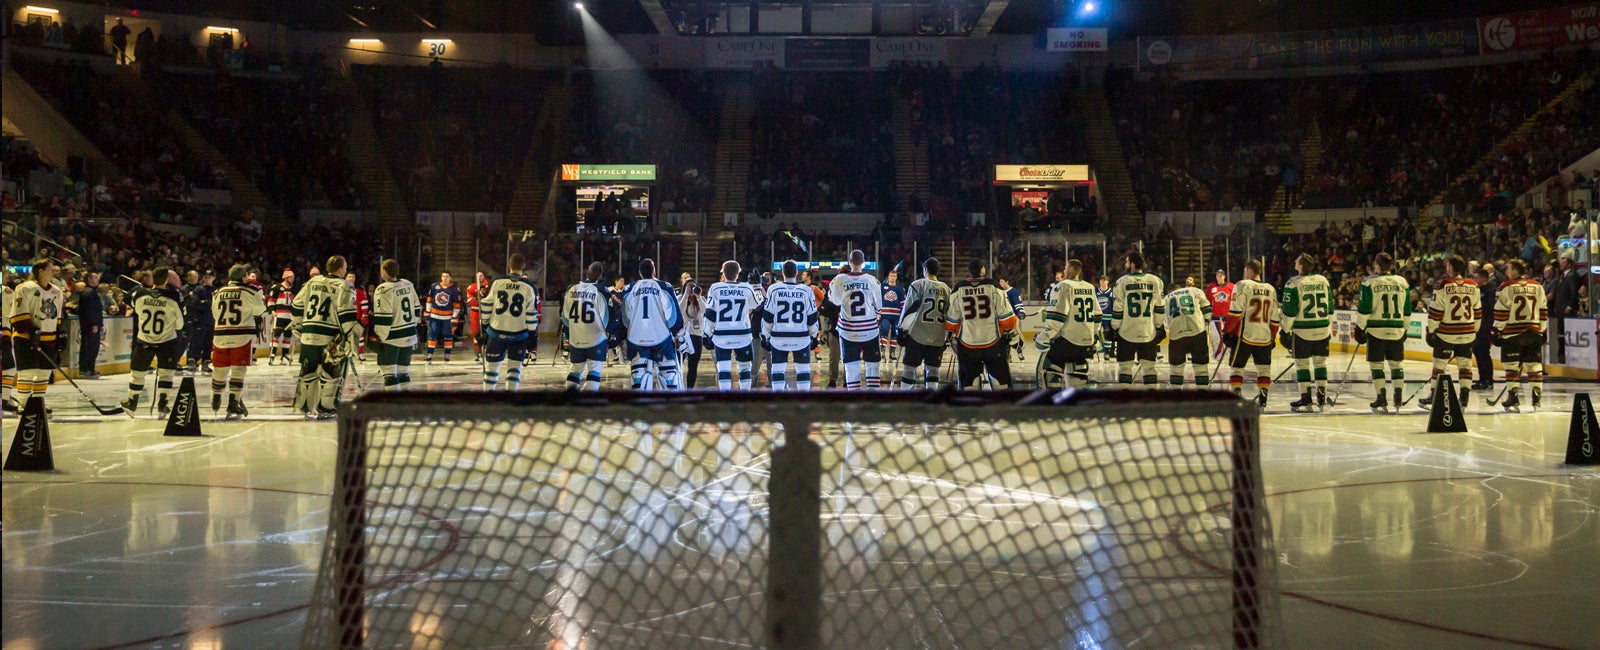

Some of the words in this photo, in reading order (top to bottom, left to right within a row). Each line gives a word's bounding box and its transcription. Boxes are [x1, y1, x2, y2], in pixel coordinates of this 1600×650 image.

[429, 43, 446, 56] 30
[1053, 40, 1101, 49] SMOKING
[1259, 42, 1298, 55] TAKE
[1304, 40, 1334, 54] THE
[1339, 38, 1372, 52] FUN
[1378, 34, 1418, 49] WITH
[1425, 30, 1464, 47] YOU!
[505, 282, 521, 291] SHAW
[719, 289, 745, 297] REMPAL
[778, 291, 804, 299] WALKER
[217, 300, 243, 326] 25
[306, 294, 332, 321] 34
[400, 296, 412, 322] 9
[495, 290, 525, 318] 38
[569, 300, 595, 324] 46
[641, 295, 649, 319] 1
[719, 299, 746, 322] 27
[776, 300, 805, 324] 28
[850, 290, 866, 317] 2
[922, 297, 946, 324] 29
[962, 295, 992, 320] 33
[1073, 297, 1094, 323] 32
[1127, 292, 1153, 318] 67
[1169, 295, 1195, 318] 49
[1249, 297, 1271, 323] 20
[1302, 292, 1328, 319] 25
[1381, 293, 1401, 319] 11
[1450, 295, 1472, 321] 23
[1513, 295, 1537, 321] 27
[141, 309, 165, 335] 26
[175, 392, 190, 427] MGM
[1581, 400, 1590, 442] LEXUS
[21, 413, 37, 456] MGM
